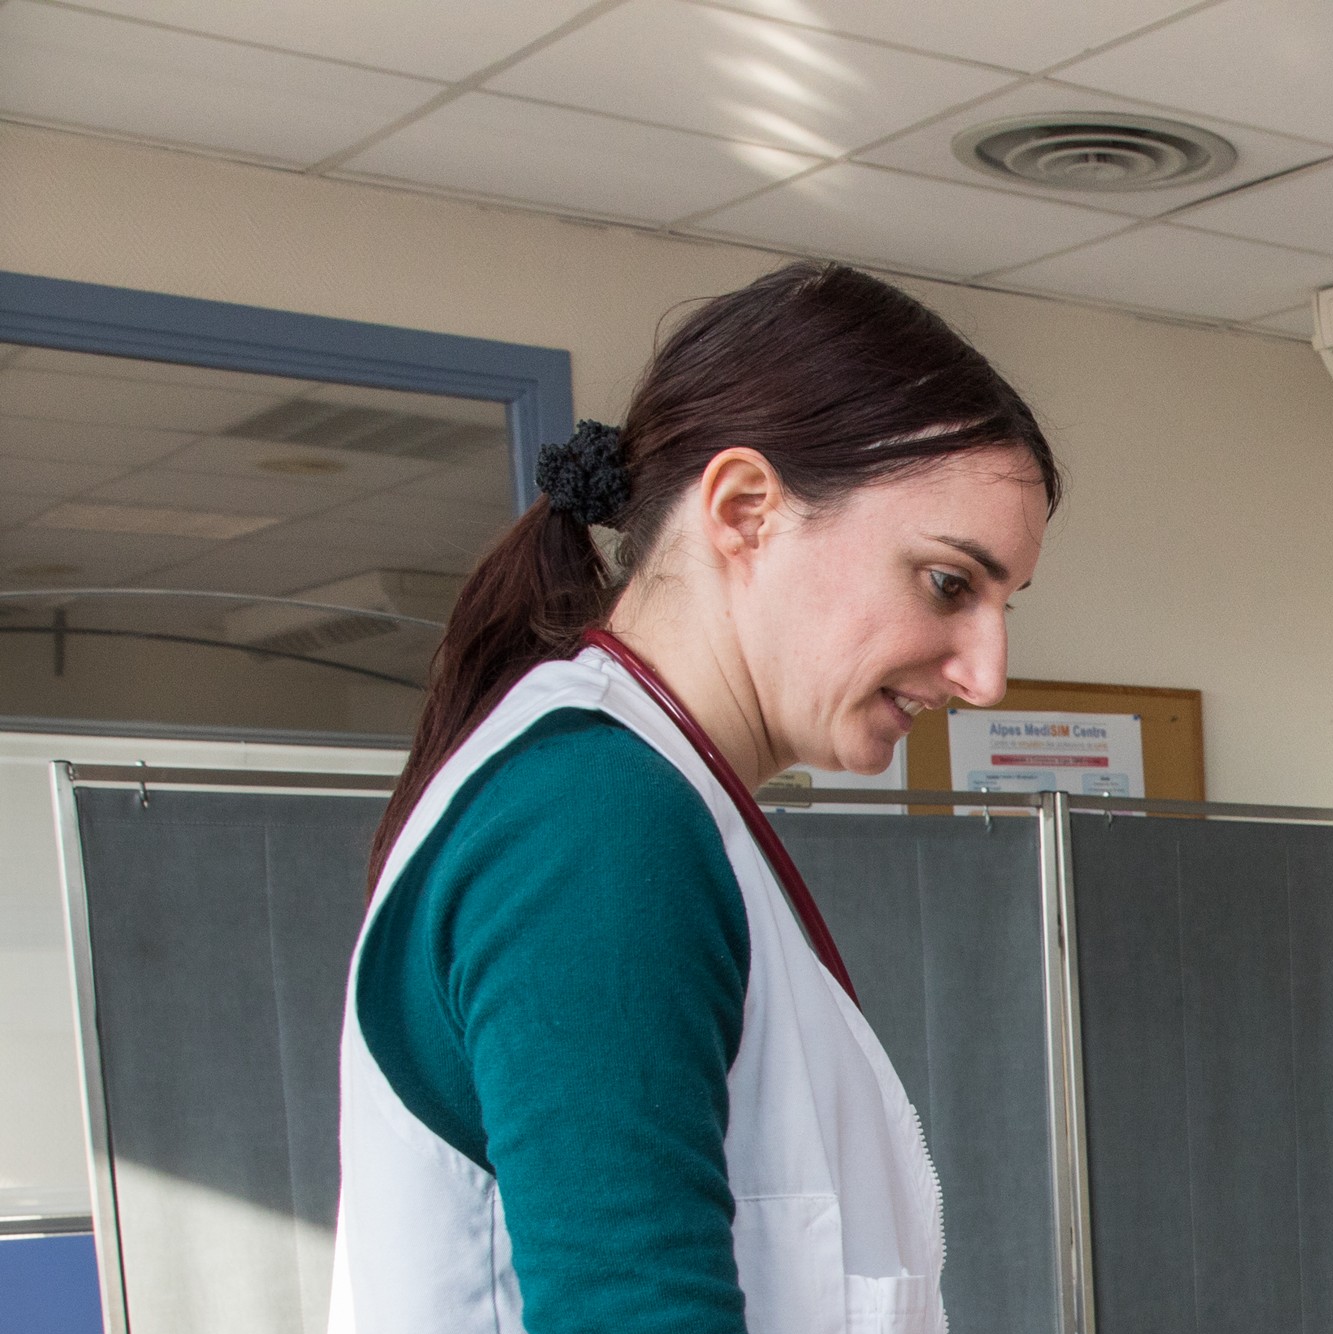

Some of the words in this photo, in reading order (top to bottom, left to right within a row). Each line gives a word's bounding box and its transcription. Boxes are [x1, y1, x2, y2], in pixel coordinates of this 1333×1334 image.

[990, 723, 1021, 737] Alpes
[1024, 723, 1070, 737] MediSIM
[1073, 725, 1107, 738] Centre
